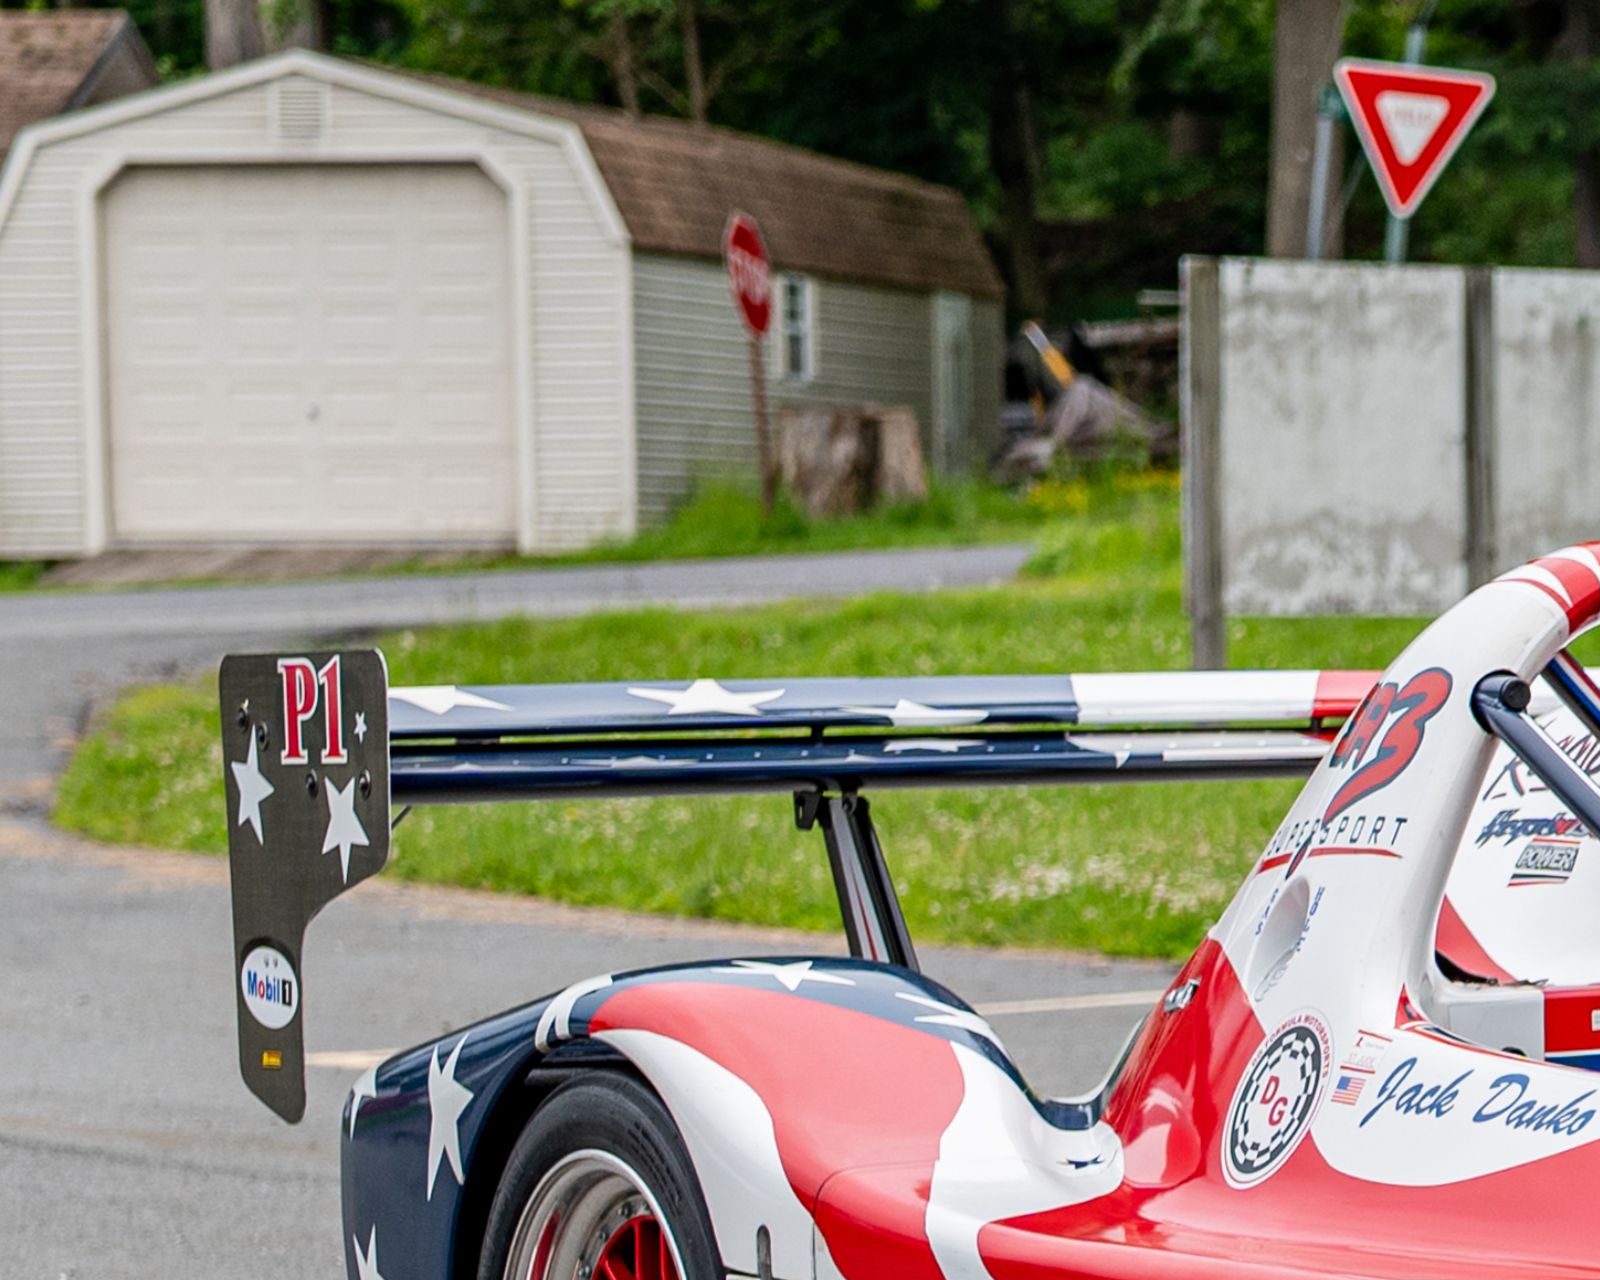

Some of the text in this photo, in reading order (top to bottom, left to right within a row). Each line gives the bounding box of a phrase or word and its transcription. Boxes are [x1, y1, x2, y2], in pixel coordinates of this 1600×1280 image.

[278, 655, 348, 765] P1
[1520, 847, 1576, 870] POWER
[247, 969, 292, 1006] Mobil 1
[1359, 1057, 1598, 1136] Jack Danko
